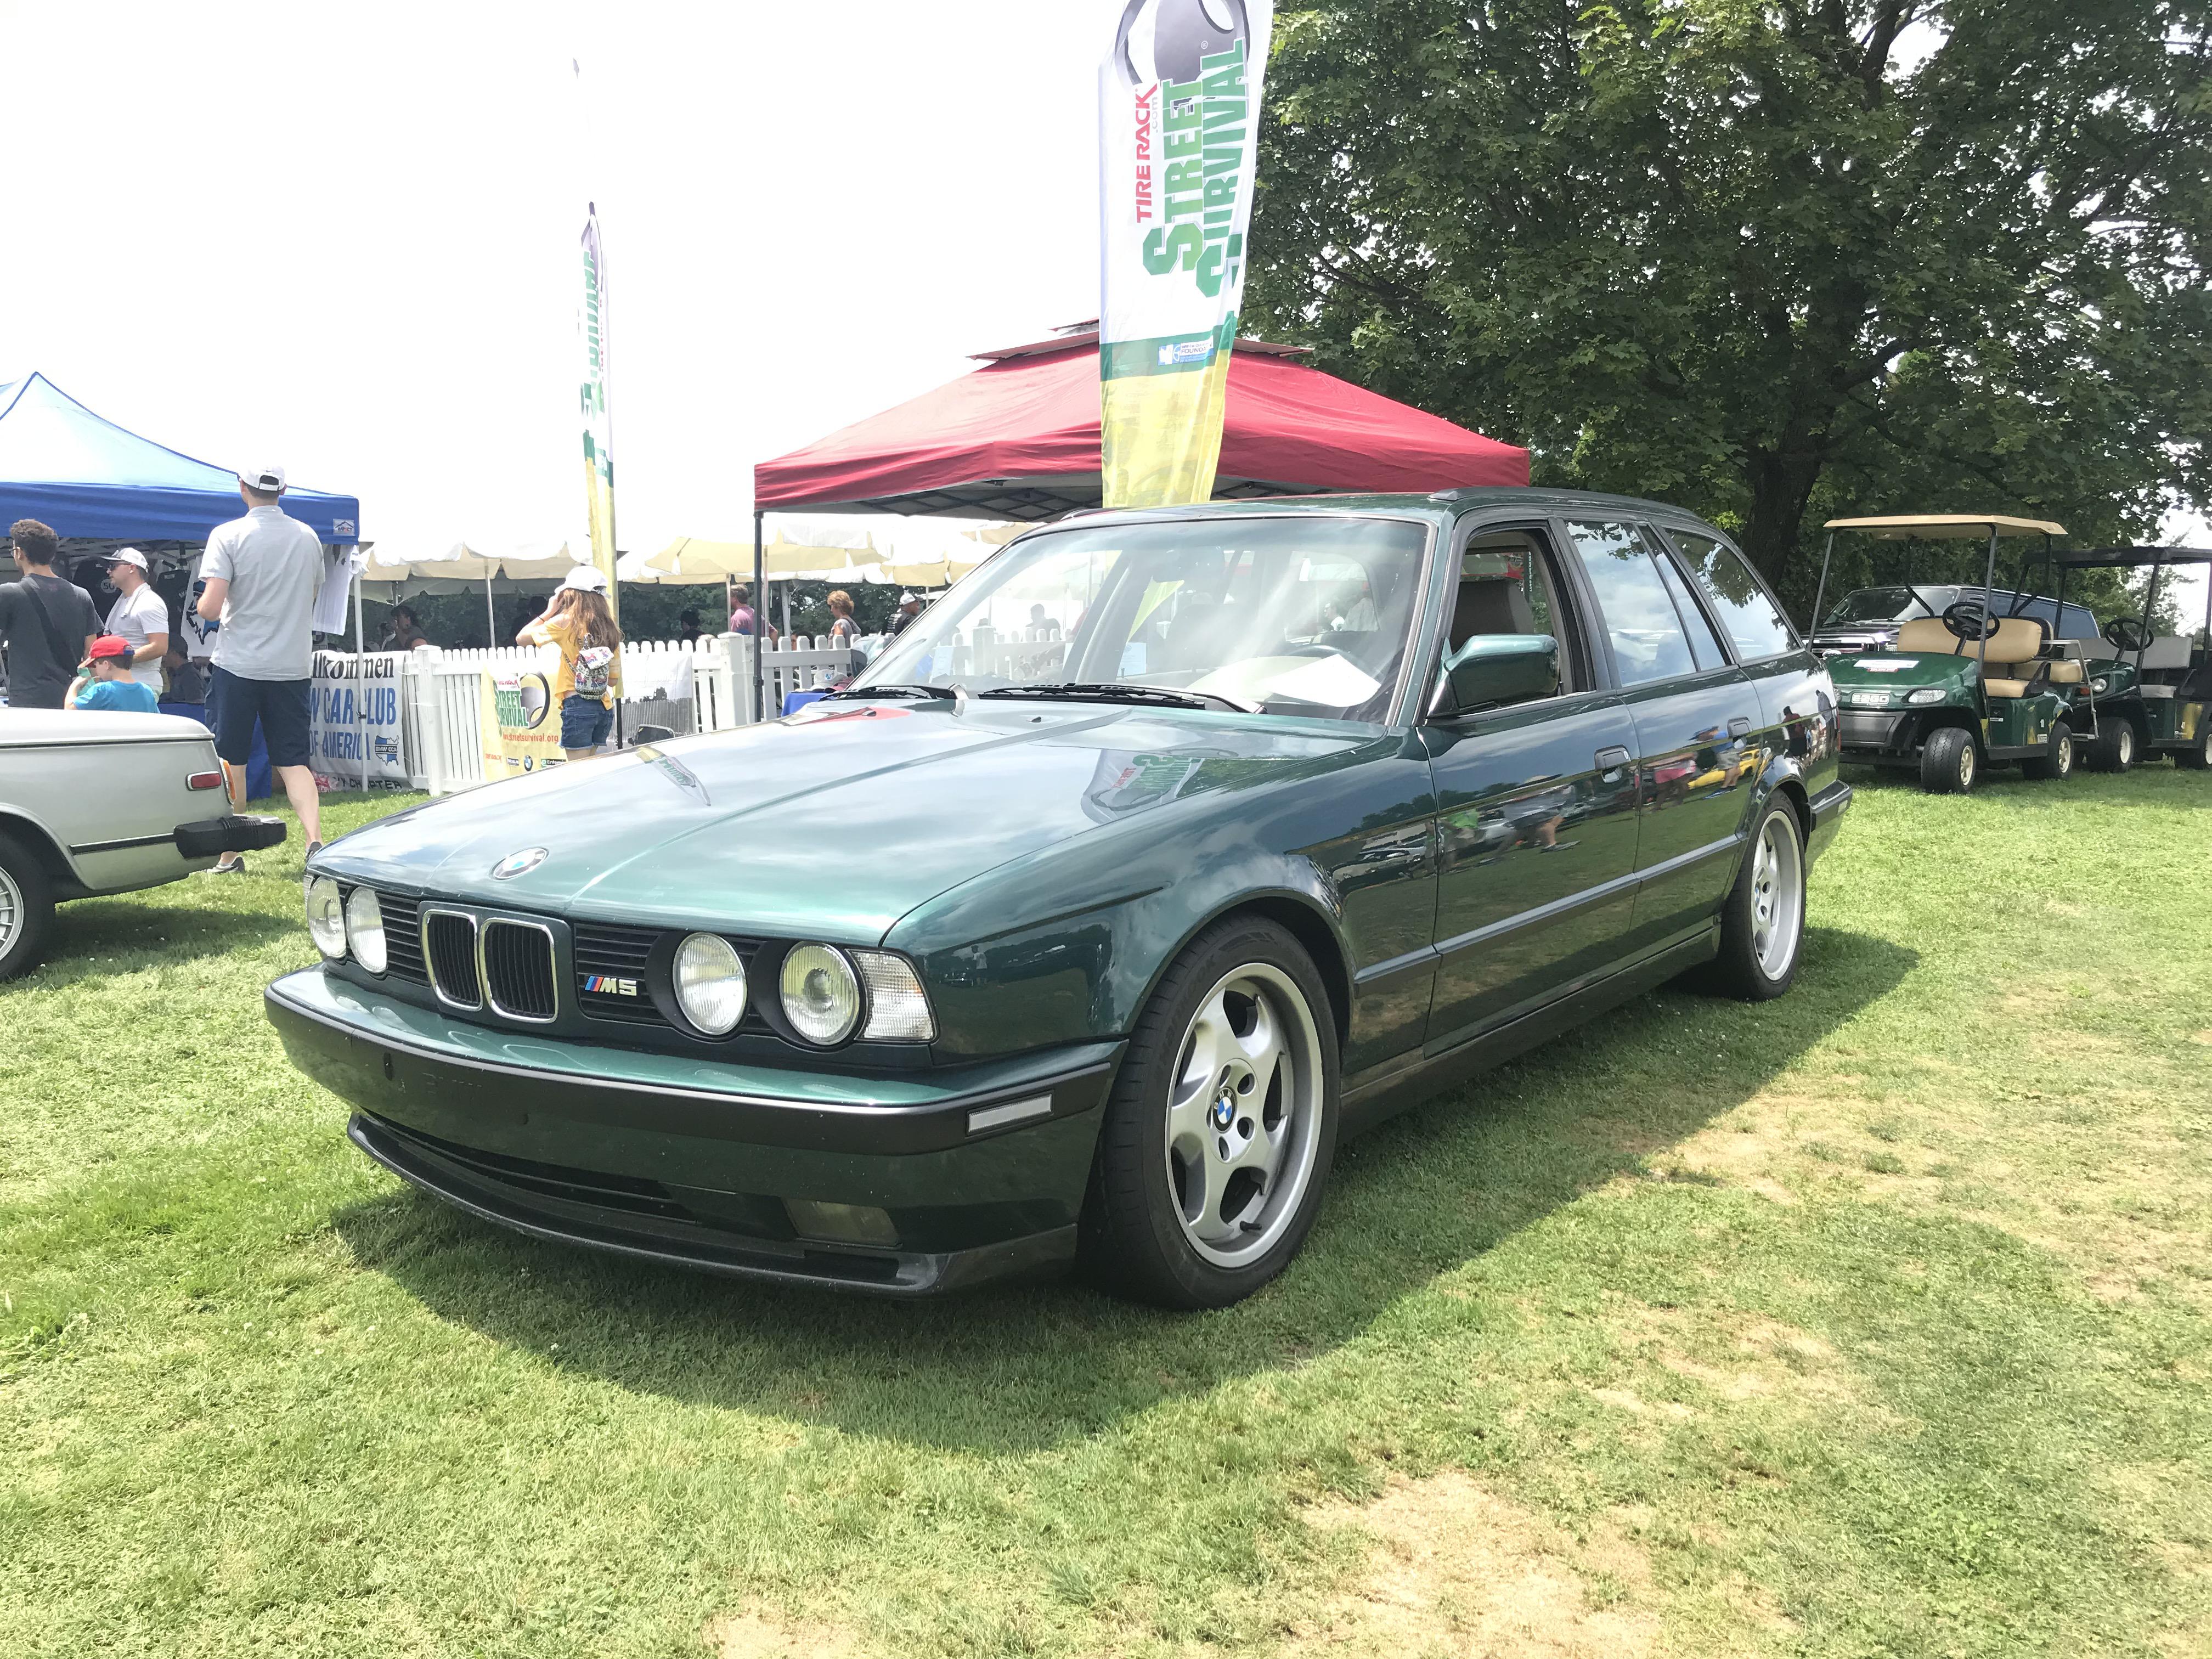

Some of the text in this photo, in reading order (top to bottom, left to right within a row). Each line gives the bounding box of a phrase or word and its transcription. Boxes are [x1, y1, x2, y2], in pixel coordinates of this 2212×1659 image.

[1136, 83, 1158, 223] TIRE RACK
[1196, 38, 1248, 298] SURVIVAL
[1143, 78, 1203, 275] STREET
[312, 652, 394, 679] llkommen
[324, 687, 354, 725] CAR
[309, 730, 319, 757] OF
[600, 977, 637, 996] M5
[1214, 1089, 1232, 1110] BMW
